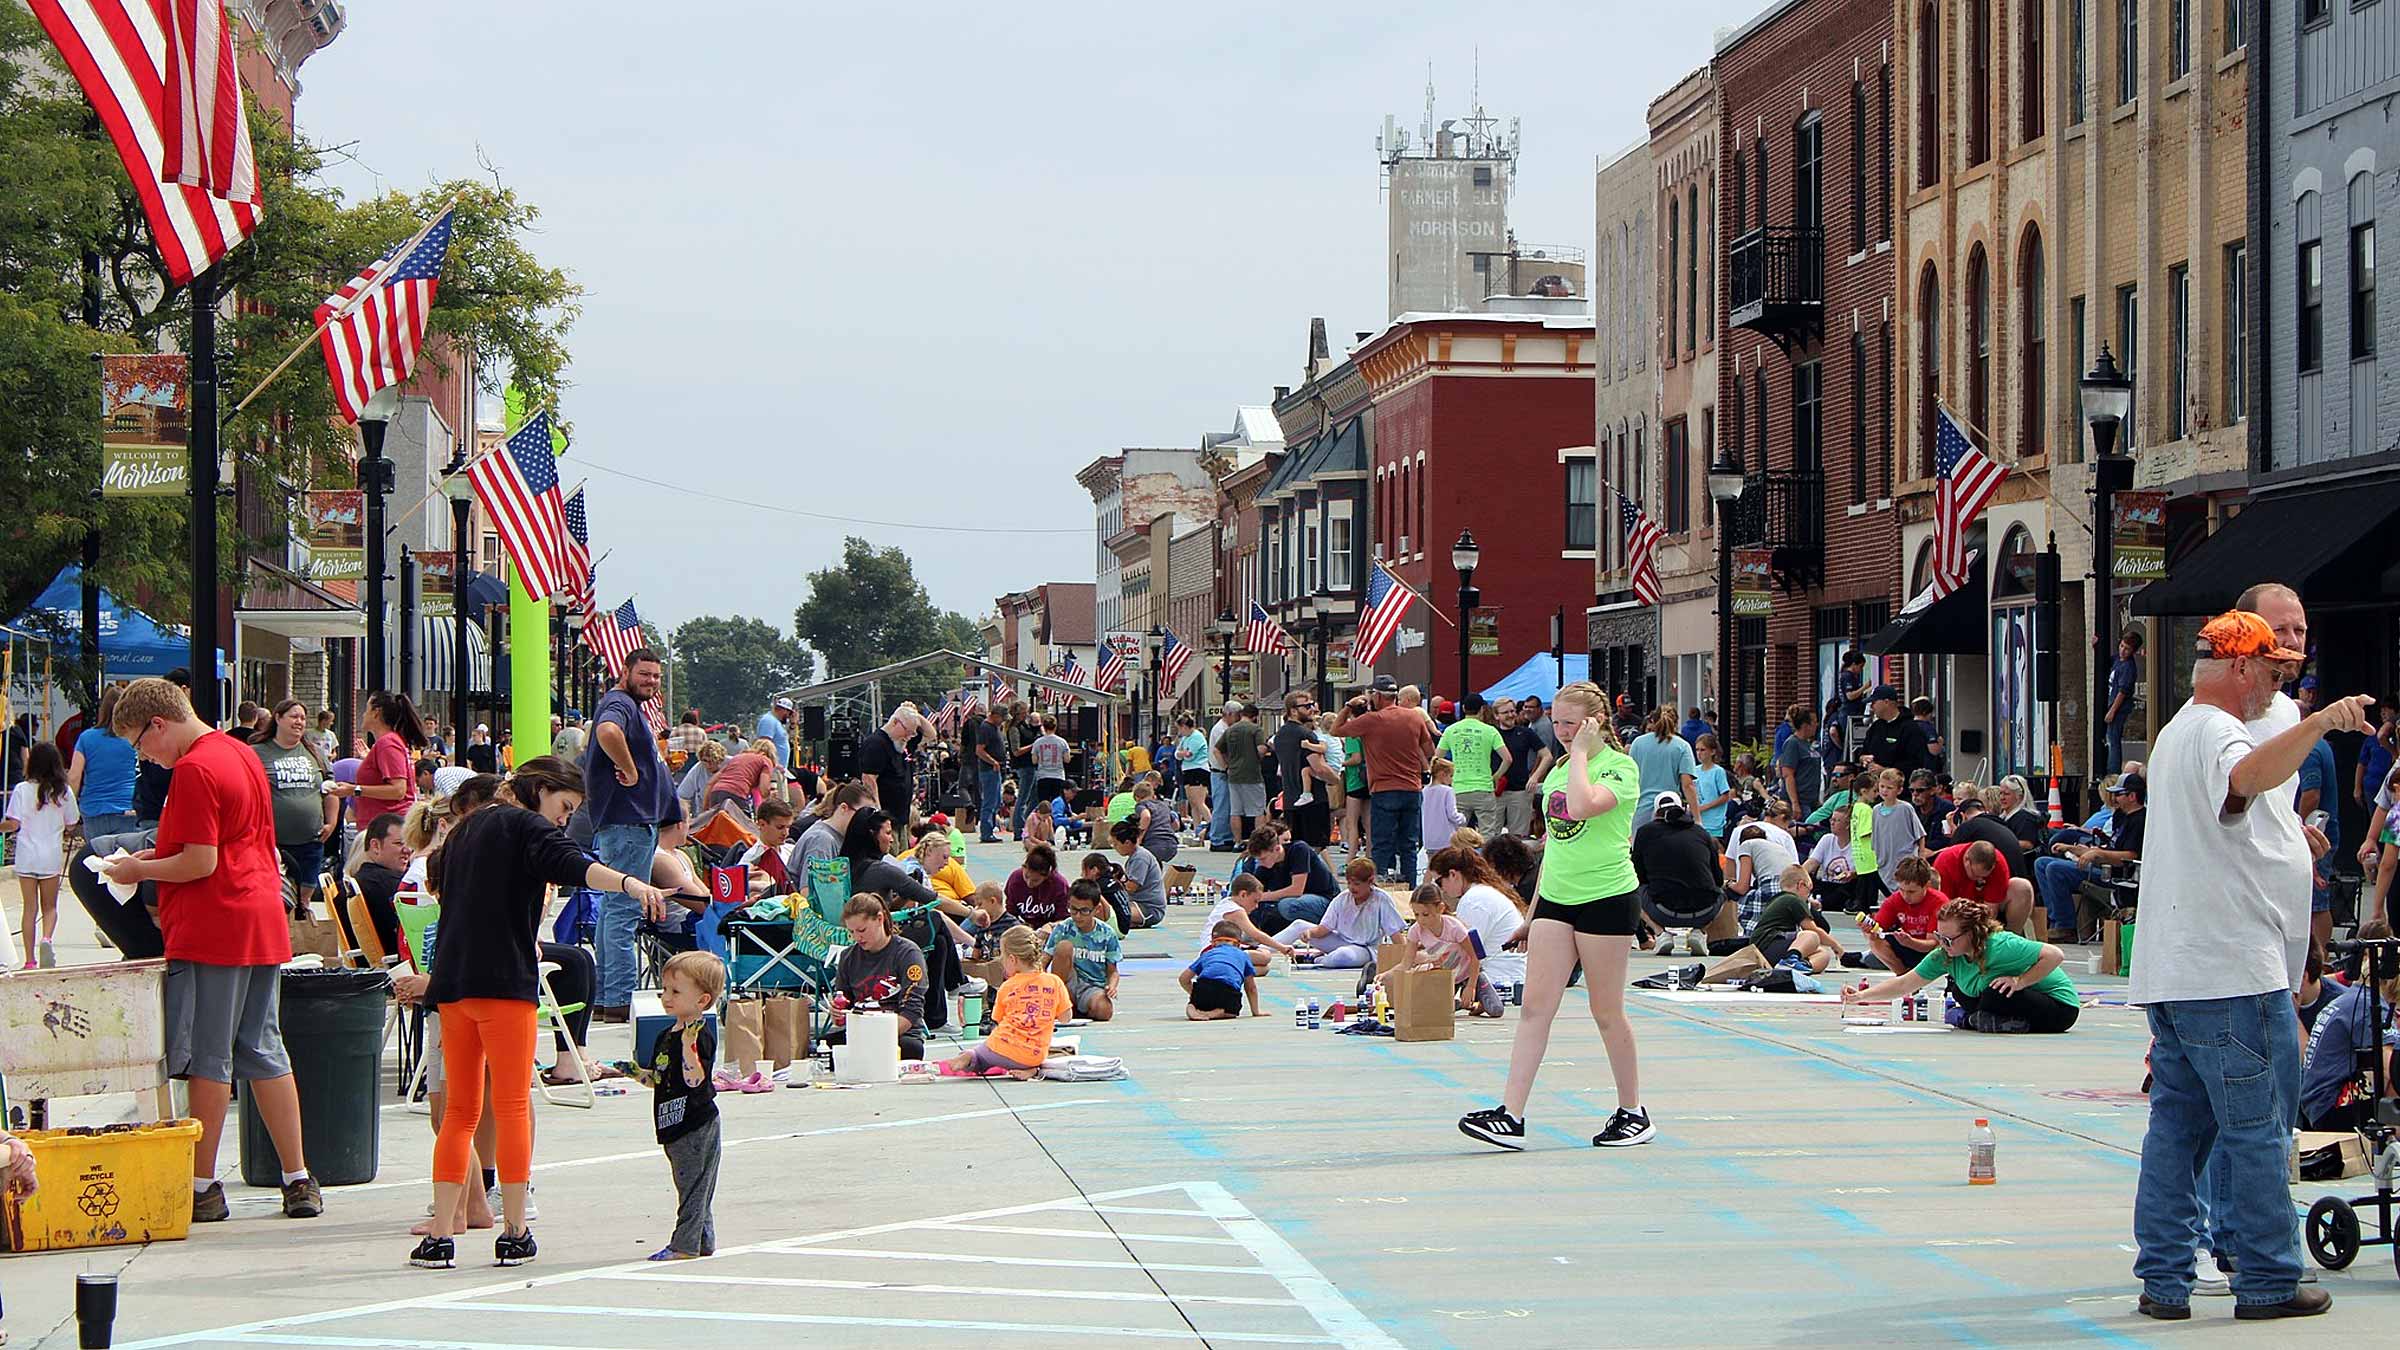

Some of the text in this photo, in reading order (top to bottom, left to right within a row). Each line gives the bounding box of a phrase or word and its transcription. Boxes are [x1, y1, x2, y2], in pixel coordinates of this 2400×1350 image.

[1408, 219, 1495, 237] MORRISON
[113, 452, 178, 460] WELCOME TO
[102, 460, 187, 490] Morrison
[310, 557, 365, 577] Morrison
[2113, 556, 2165, 575] Morrison
[1733, 598, 1771, 612] Morrison
[273, 758, 313, 770] NURSE
[1072, 947, 1106, 963] RTNITE
[90, 1164, 104, 1172] WE
[79, 1172, 115, 1182] RECYCLE
